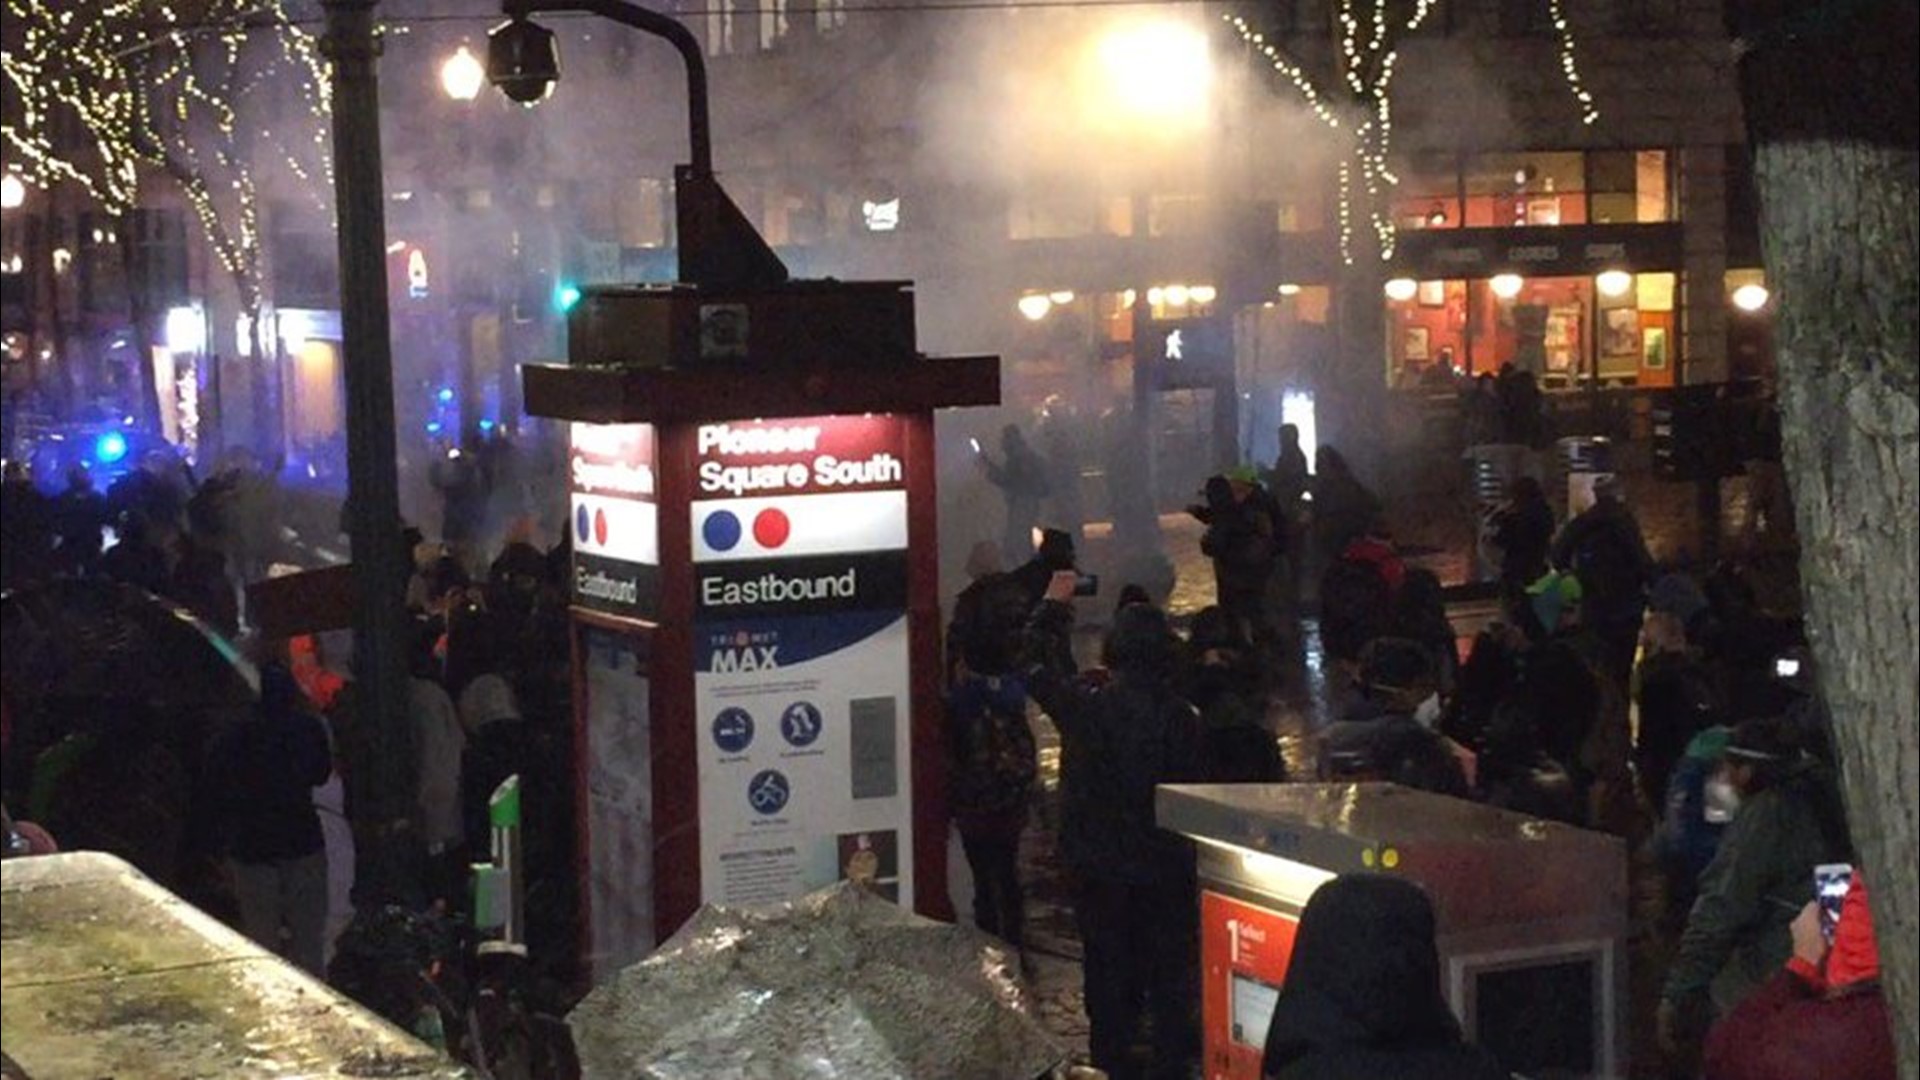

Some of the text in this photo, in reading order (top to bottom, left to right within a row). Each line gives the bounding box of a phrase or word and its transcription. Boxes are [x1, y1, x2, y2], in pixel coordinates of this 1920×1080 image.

[699, 425, 820, 454] Pioneer
[700, 454, 901, 495] Square South
[702, 569, 855, 605] Eastbound
[711, 646, 778, 673] MAX
[1226, 919, 1238, 962] 1
